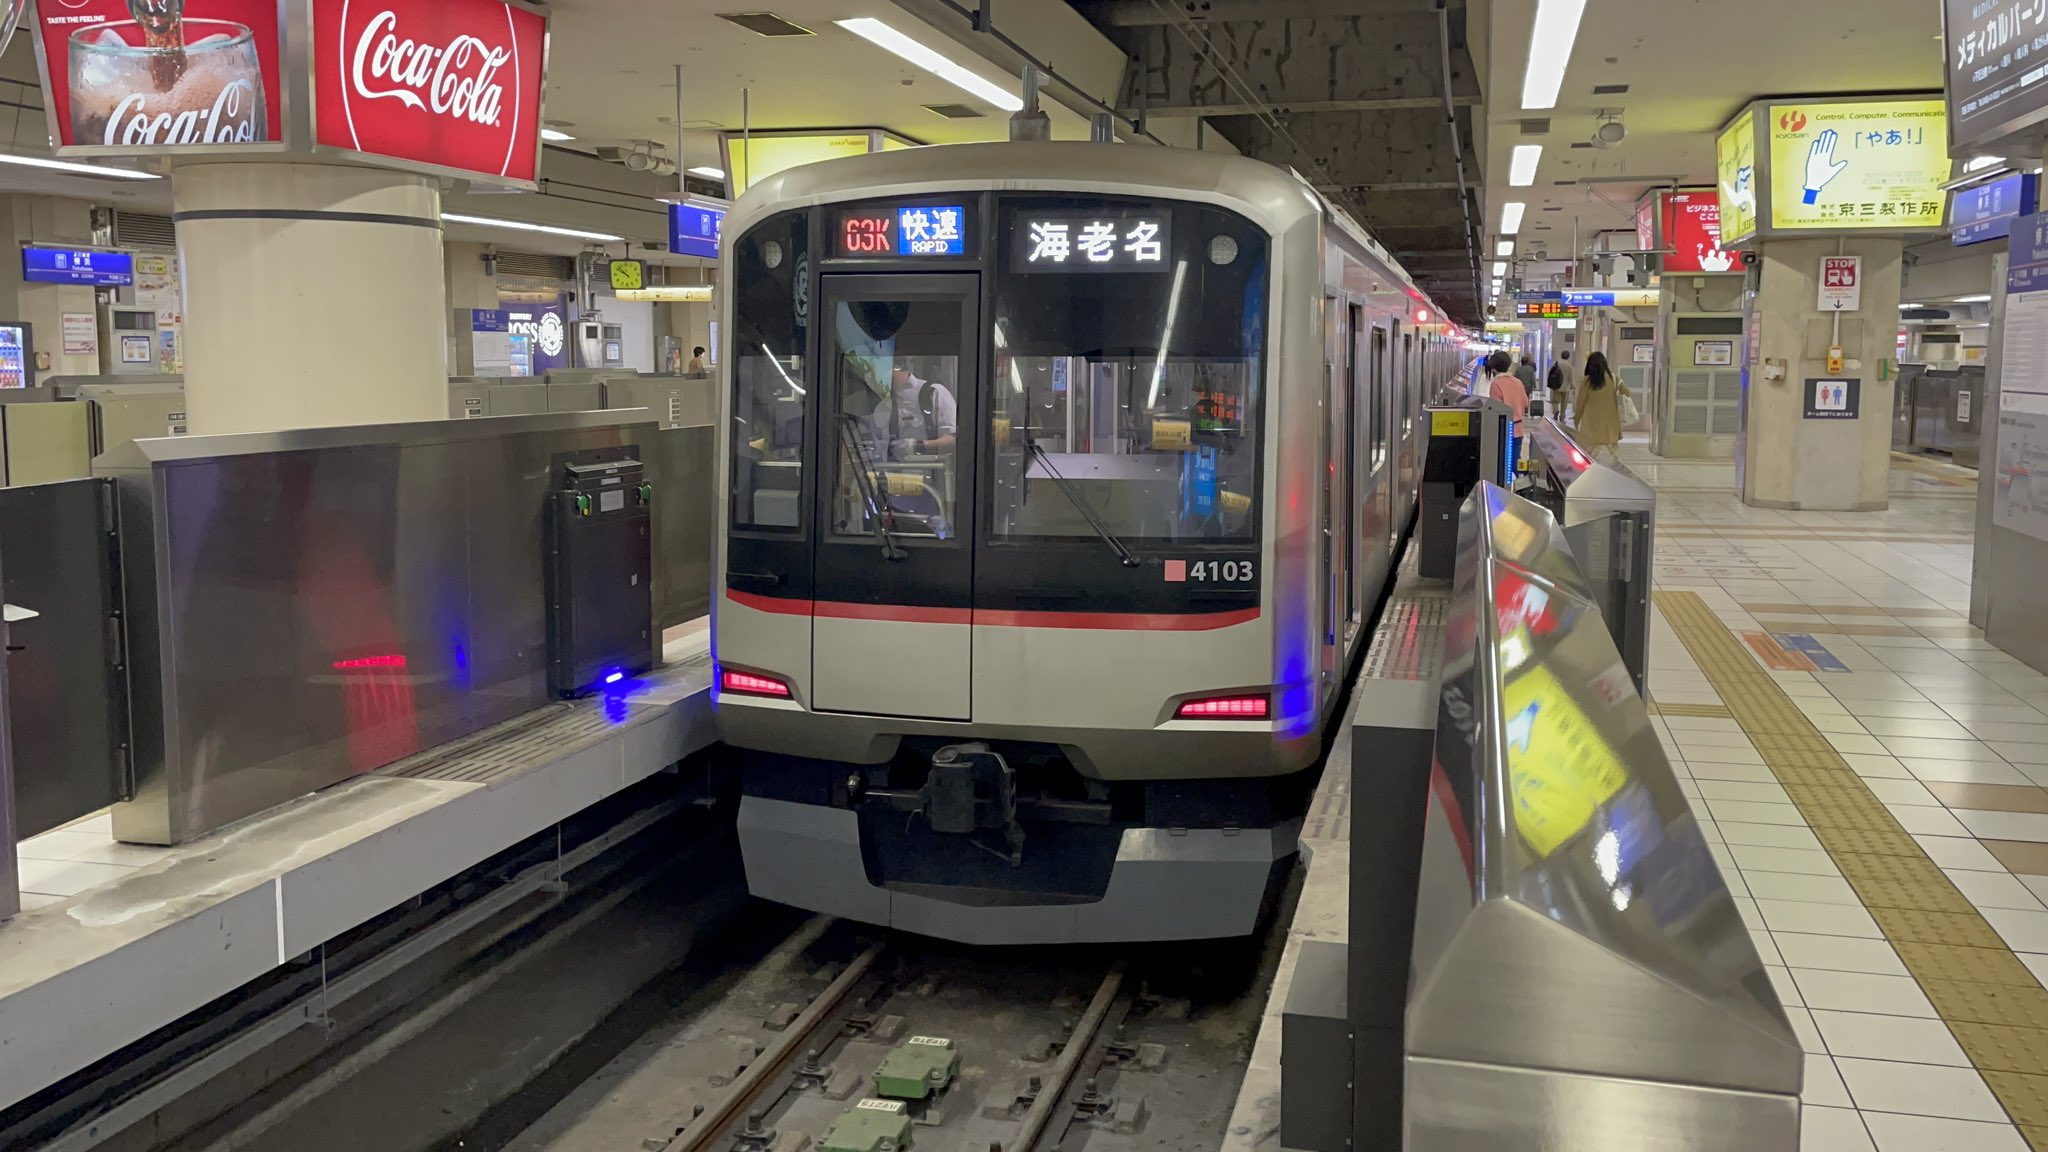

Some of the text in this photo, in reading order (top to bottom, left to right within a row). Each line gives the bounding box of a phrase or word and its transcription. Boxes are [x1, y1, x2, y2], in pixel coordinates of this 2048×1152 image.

[47, 16, 66, 24] TASTE
[79, 15, 105, 23] FEELING
[353, 10, 512, 126] Coca-Cola
[1686, 204, 1719, 213] ビジネス
[1839, 201, 1938, 216] 京三製作所
[902, 209, 958, 240] 快速
[847, 218, 890, 251] 63K
[1029, 221, 1161, 262] 海老名
[911, 240, 948, 253] RAPID
[1827, 260, 1855, 268] STOP
[1565, 294, 1573, 305] 2
[1190, 561, 1254, 581] 4103
